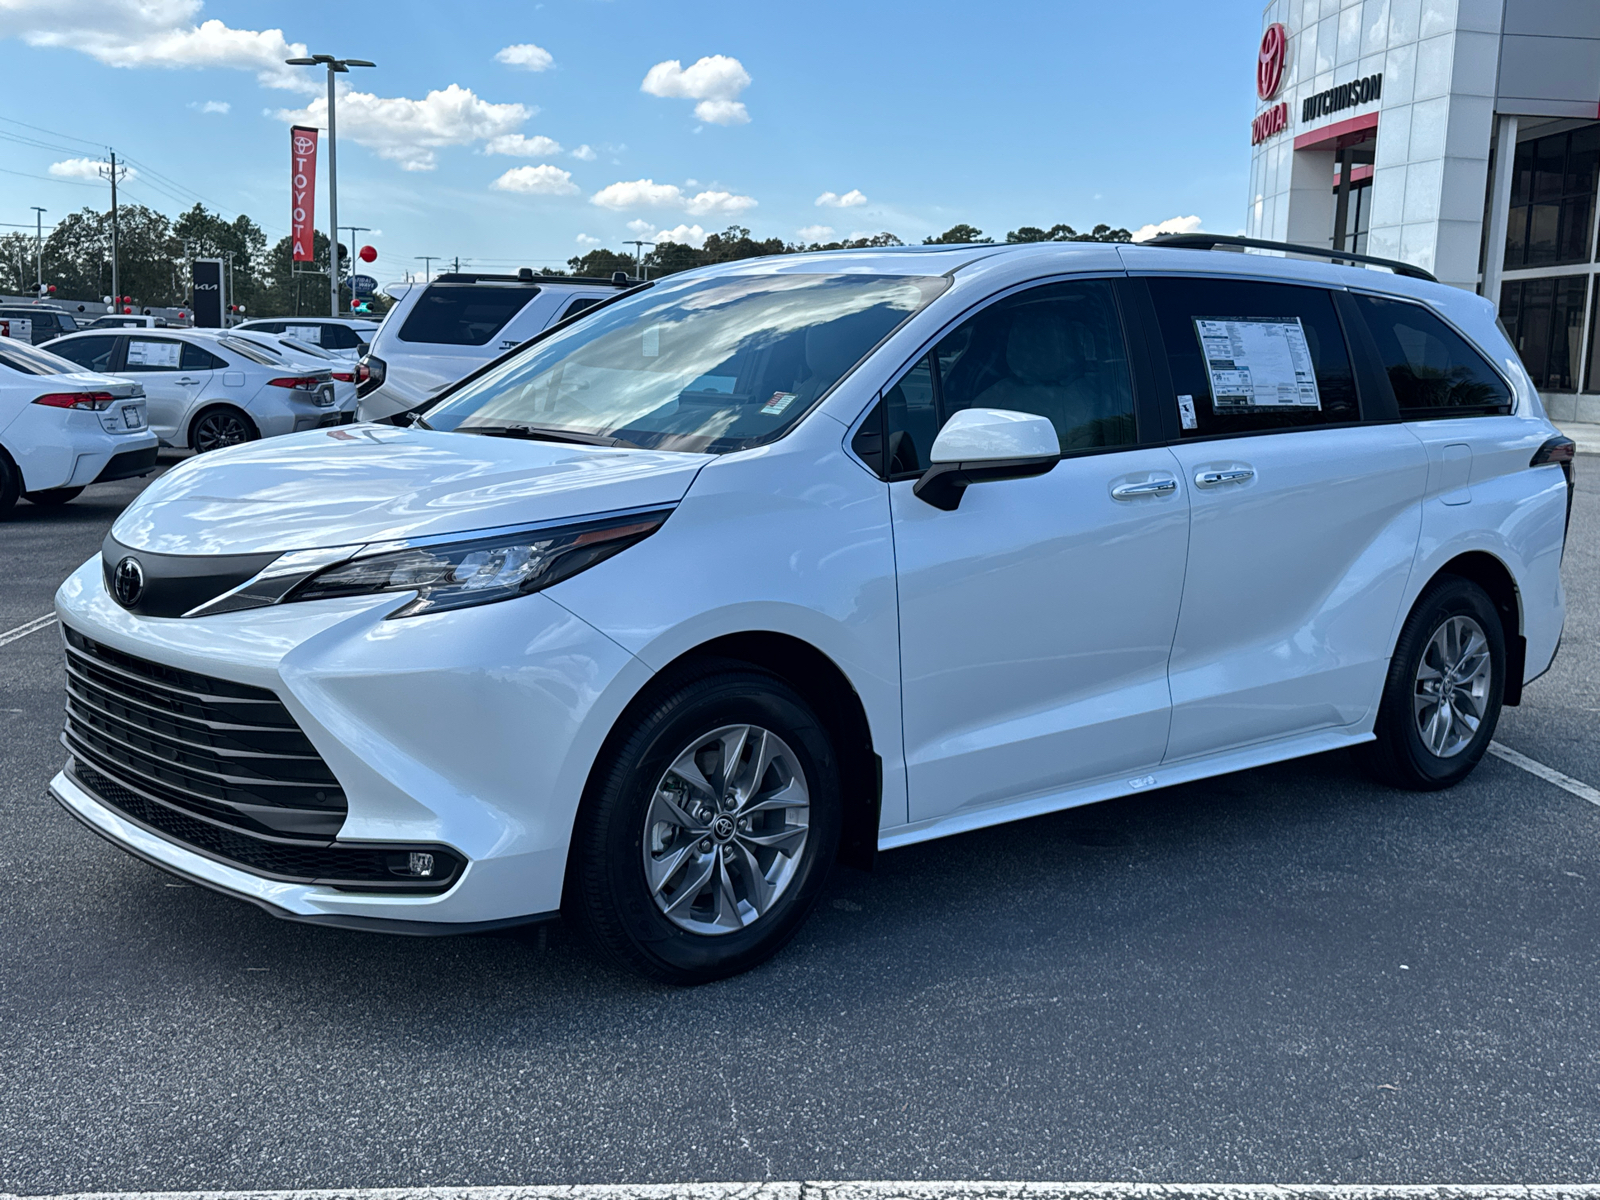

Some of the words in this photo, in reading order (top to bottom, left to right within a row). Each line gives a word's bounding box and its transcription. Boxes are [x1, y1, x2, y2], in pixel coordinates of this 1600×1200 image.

[1302, 73, 1382, 123] HUTCHINSON
[1251, 102, 1287, 146] TOYOTA
[293, 158, 307, 255] TOYOTA
